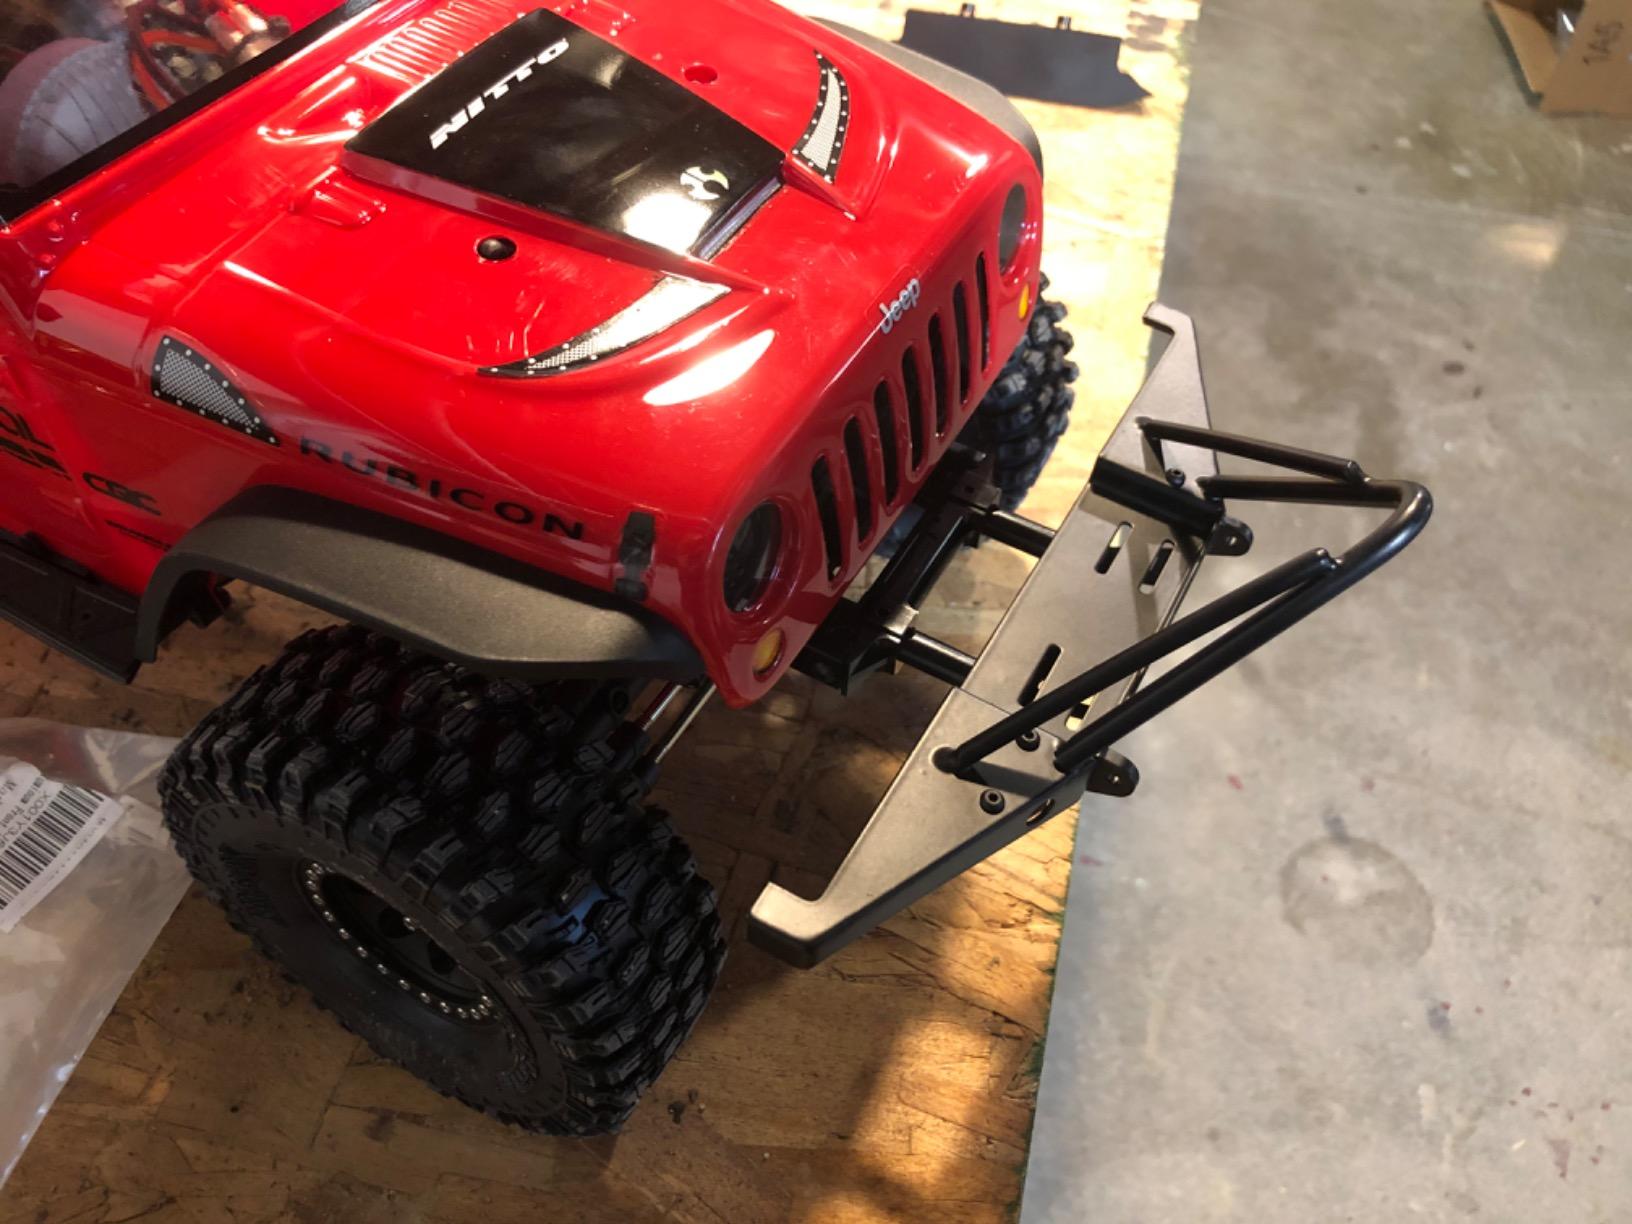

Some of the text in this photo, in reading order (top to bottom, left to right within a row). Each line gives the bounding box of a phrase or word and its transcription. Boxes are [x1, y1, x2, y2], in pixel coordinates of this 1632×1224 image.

[429, 38, 570, 150] NITTO
[879, 278, 920, 334] Jeep
[300, 434, 586, 541] RUBICON
